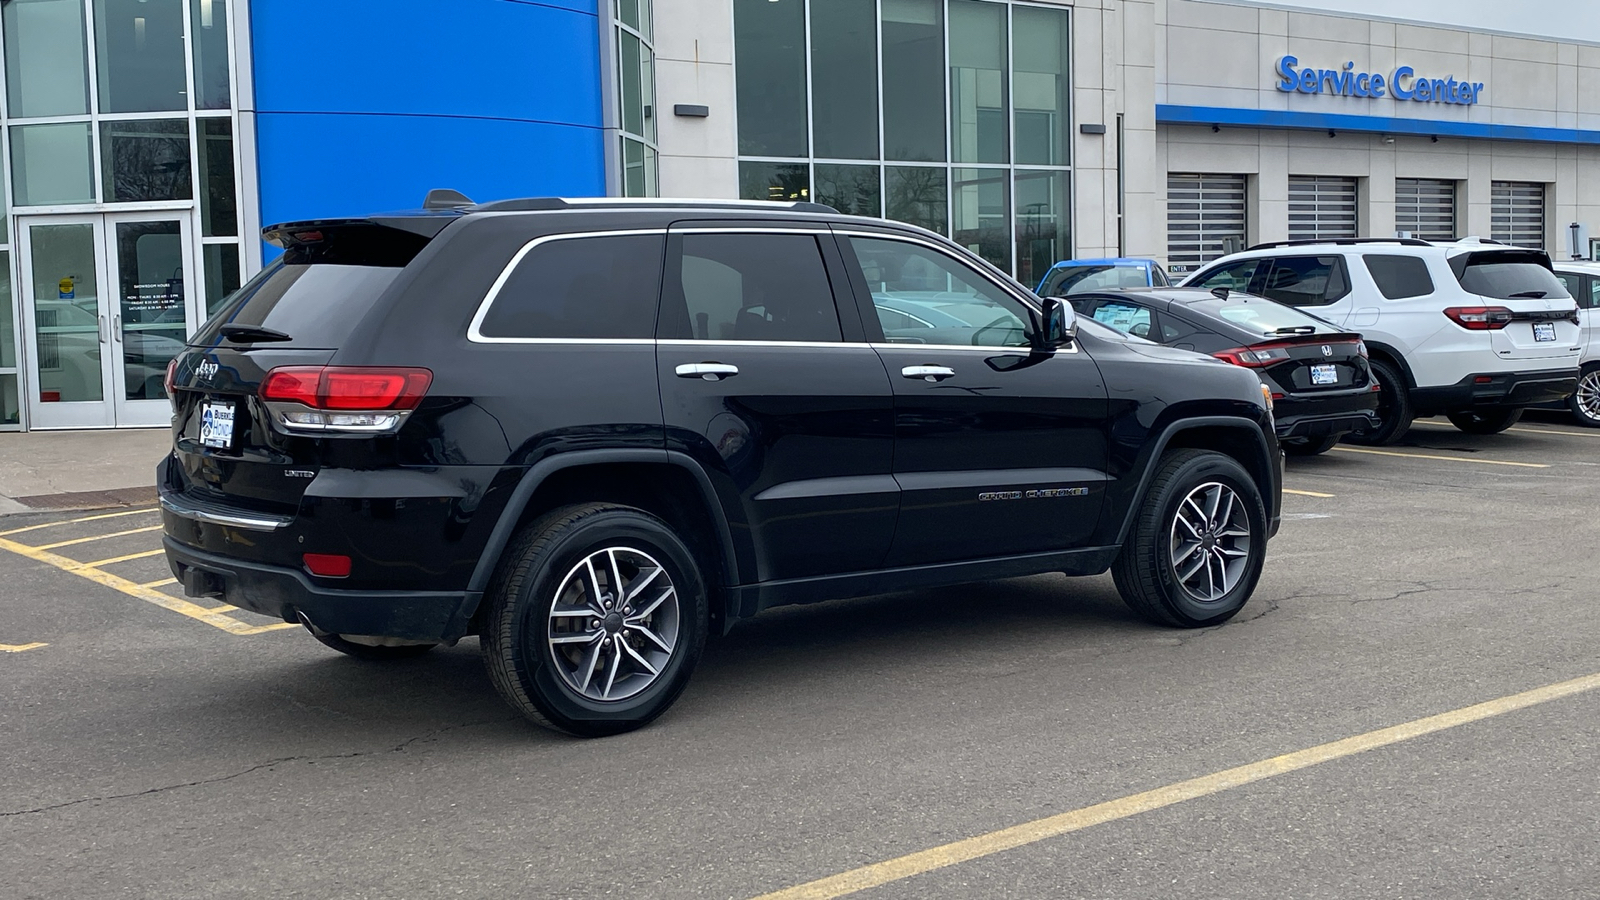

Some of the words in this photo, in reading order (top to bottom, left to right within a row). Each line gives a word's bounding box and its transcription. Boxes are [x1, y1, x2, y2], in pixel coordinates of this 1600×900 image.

[1276, 55, 1385, 98] Service
[1389, 66, 1484, 104] Center
[195, 359, 218, 380] Jeep
[214, 409, 234, 420] BUERKLE
[979, 491, 1022, 500] GRAND
[1026, 487, 1089, 498] CHEROKEE
